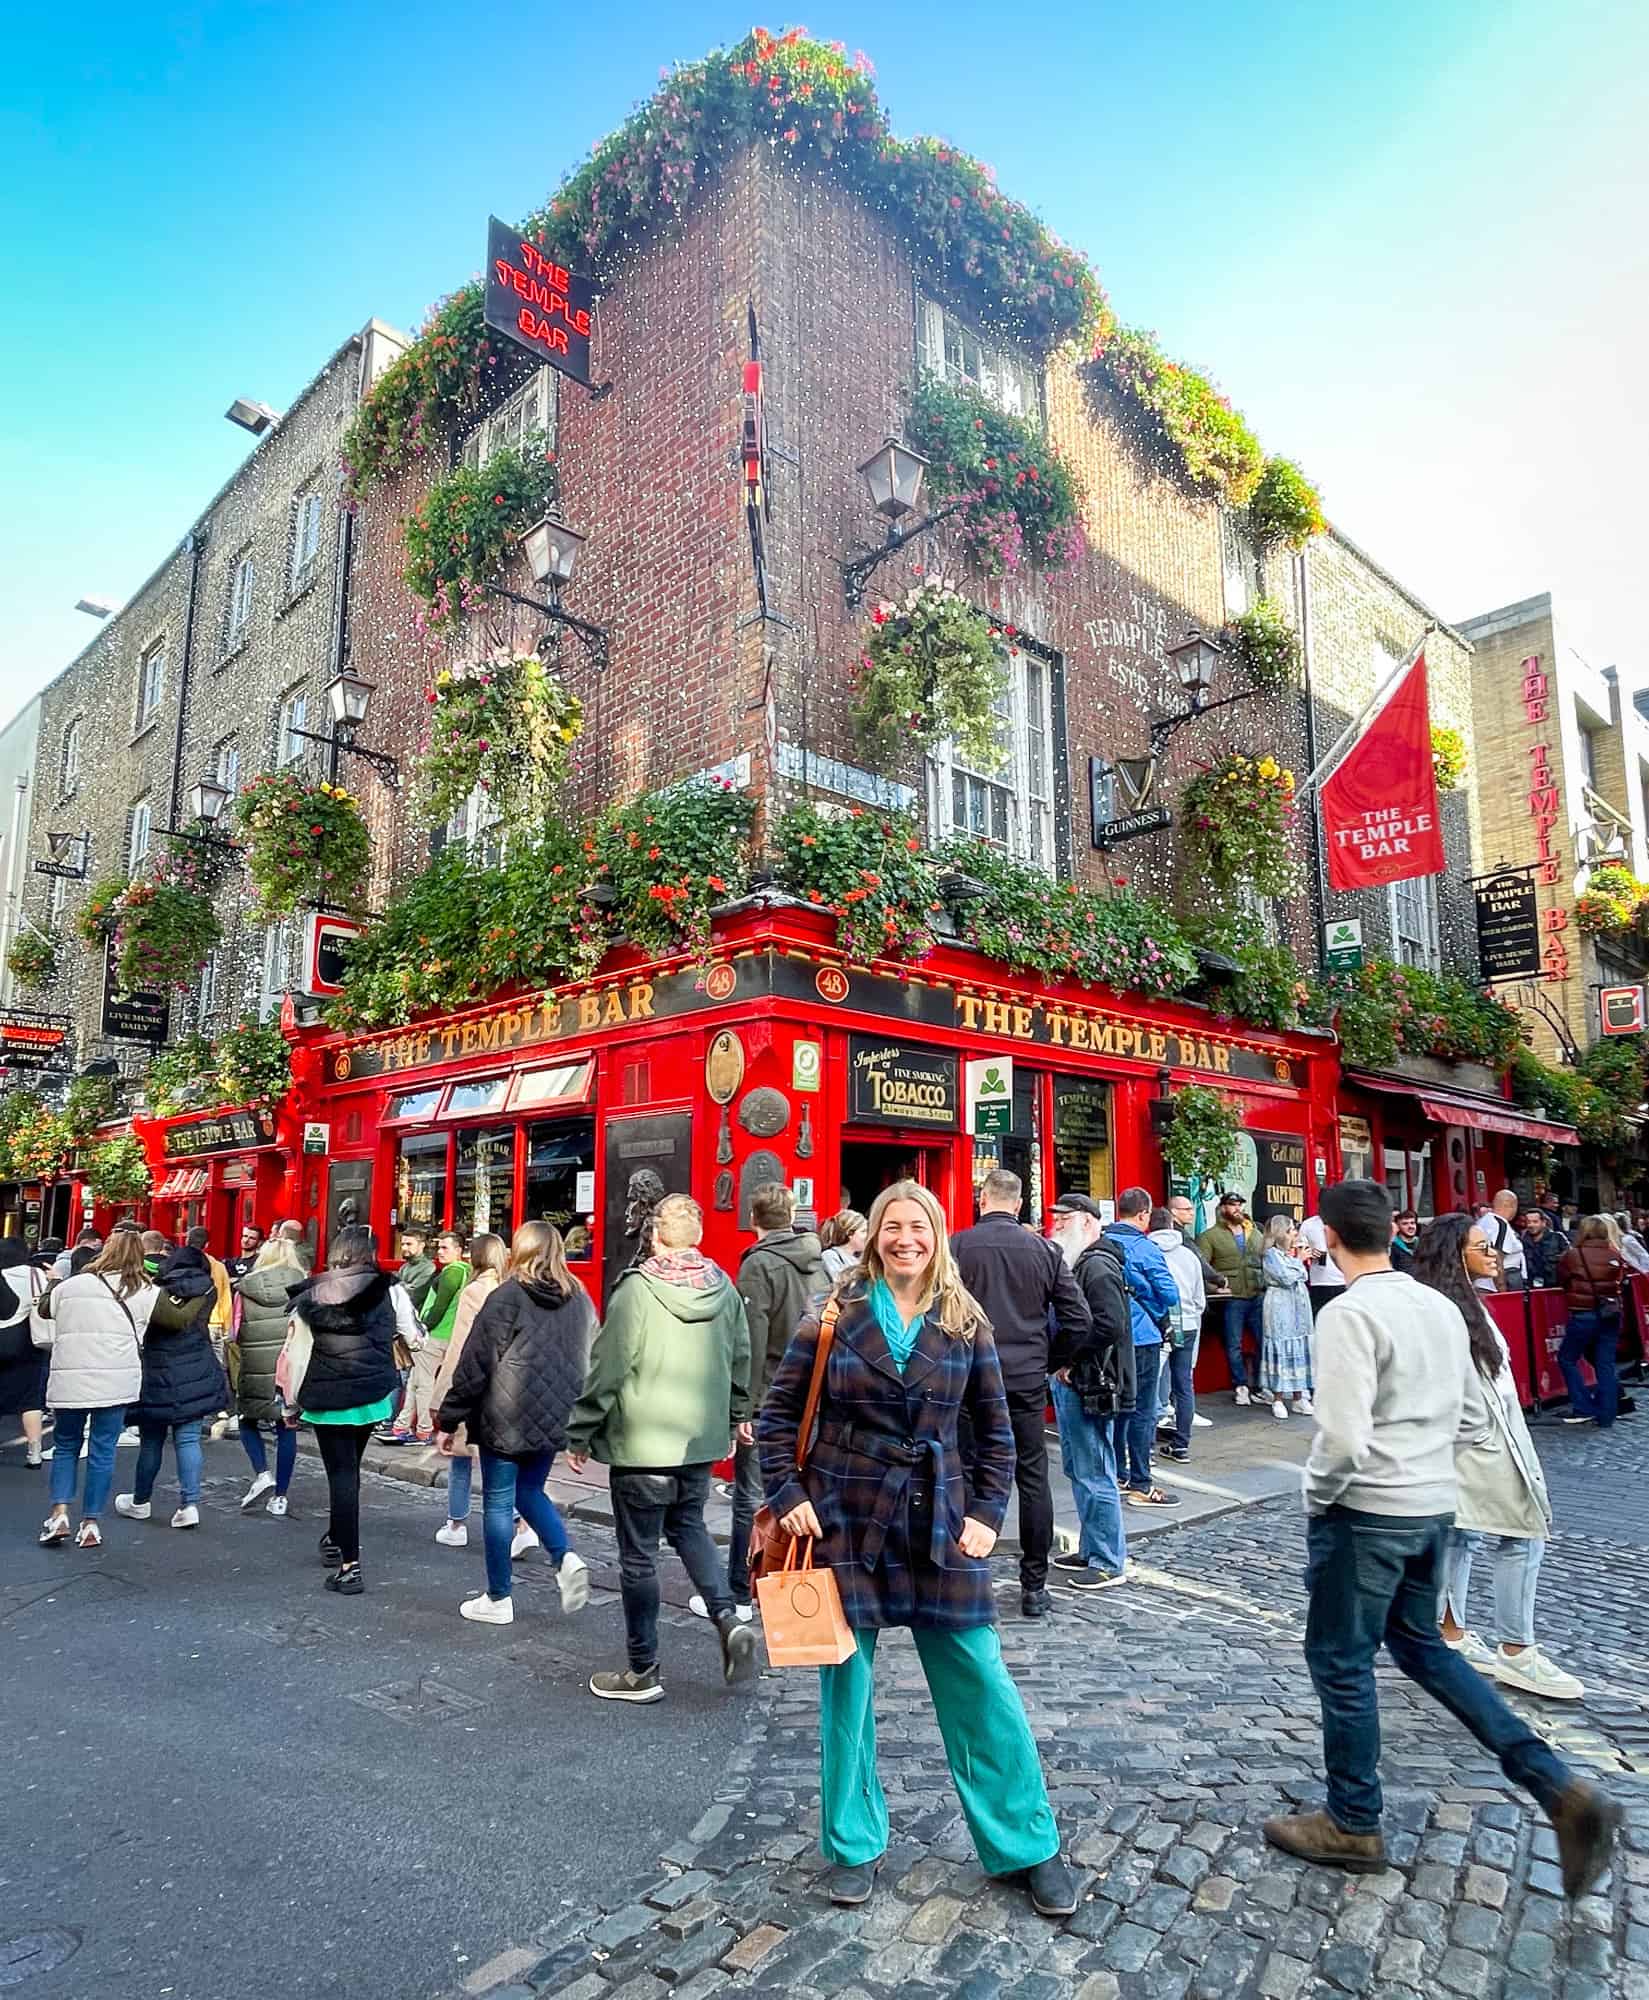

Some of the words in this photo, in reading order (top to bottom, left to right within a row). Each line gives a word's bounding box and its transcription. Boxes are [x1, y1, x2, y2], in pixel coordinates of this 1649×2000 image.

[520, 241, 569, 293] THE
[495, 259, 591, 337] TEMPLE
[518, 308, 568, 357] BAR
[1083, 619, 1165, 661] TEMPLE
[1521, 656, 1549, 724] THE
[1104, 811, 1161, 836] GUINNESS
[1334, 813, 1433, 848] TEMPLE
[1360, 807, 1402, 825] THE
[1528, 744, 1560, 886] TEMPLE
[1360, 838, 1411, 860] BAR
[1478, 885, 1535, 903] TEMPLE
[1491, 900, 1522, 913] BAR
[1543, 907, 1569, 982] BAR
[109, 1011, 131, 1021] LIVE
[132, 1014, 163, 1025] MUSIC
[120, 1022, 149, 1031] DAILY
[380, 1031, 433, 1071] THE
[440, 1005, 563, 1058] TEMPLE
[578, 983, 656, 1029] BAR
[956, 995, 1034, 1039] THE
[1046, 1012, 1167, 1062] TEMPLE
[1178, 1038, 1231, 1073] BAR
[853, 1047, 900, 1070] Importers
[894, 1067, 911, 1080] FINE
[911, 1069, 946, 1083] SMOKING
[173, 1130, 194, 1149] THE
[193, 1124, 233, 1147] TEMPLE
[232, 1119, 257, 1140] BAR
